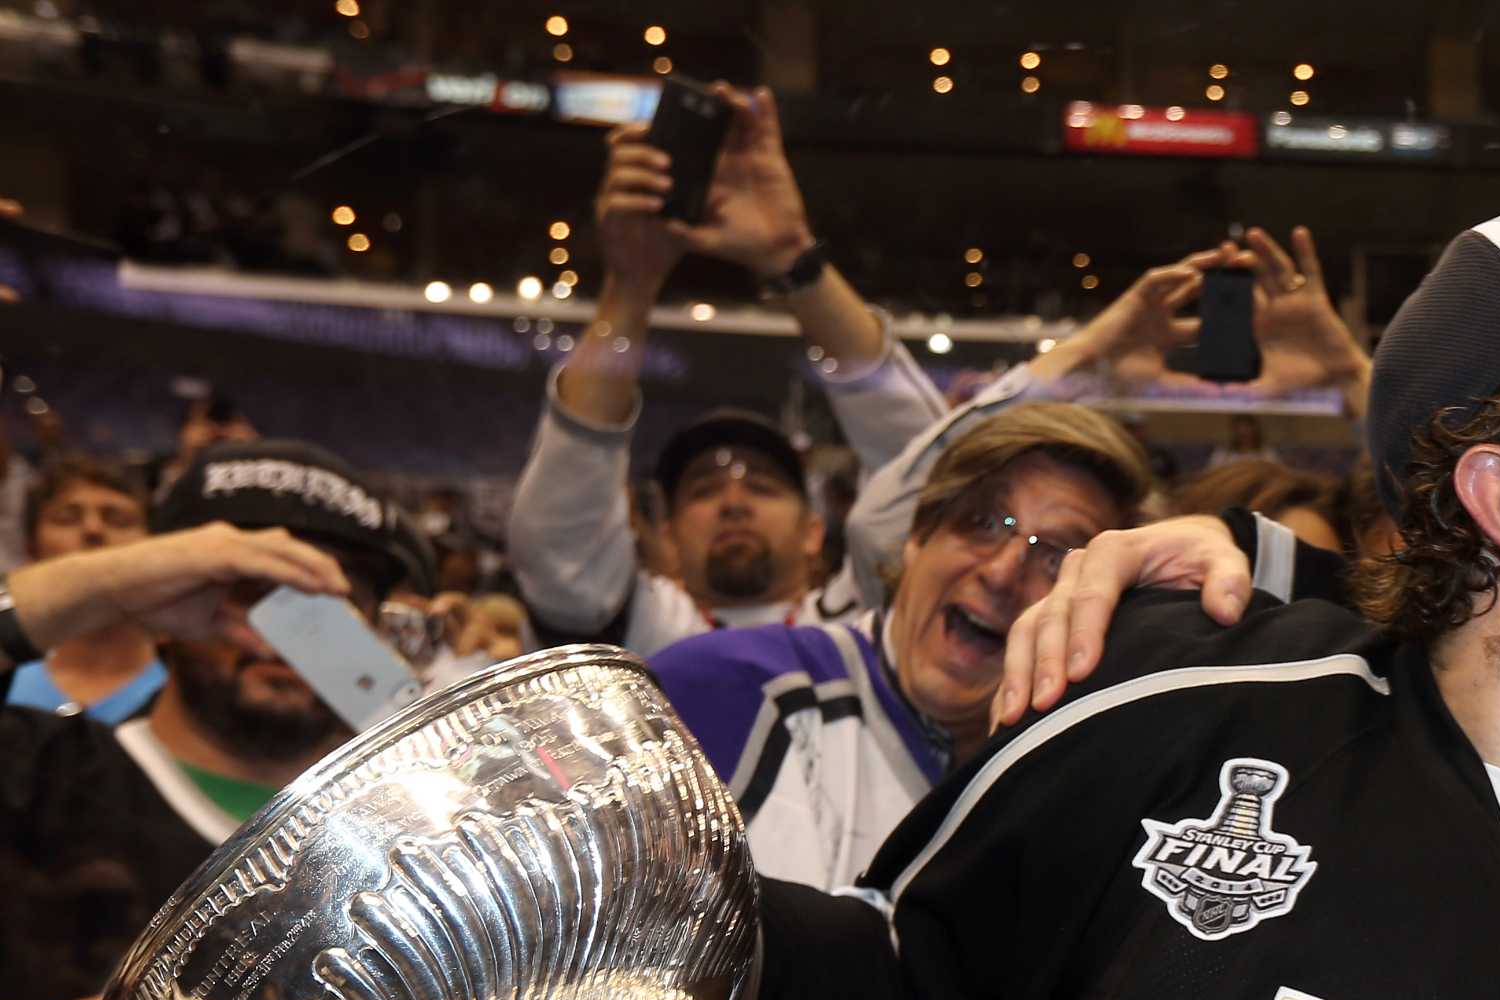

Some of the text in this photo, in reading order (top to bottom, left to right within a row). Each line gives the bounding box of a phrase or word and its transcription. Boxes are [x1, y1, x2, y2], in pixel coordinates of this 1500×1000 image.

[1154, 837, 1299, 882] FINAL
[1182, 828, 1286, 855] STANLEY CUP
